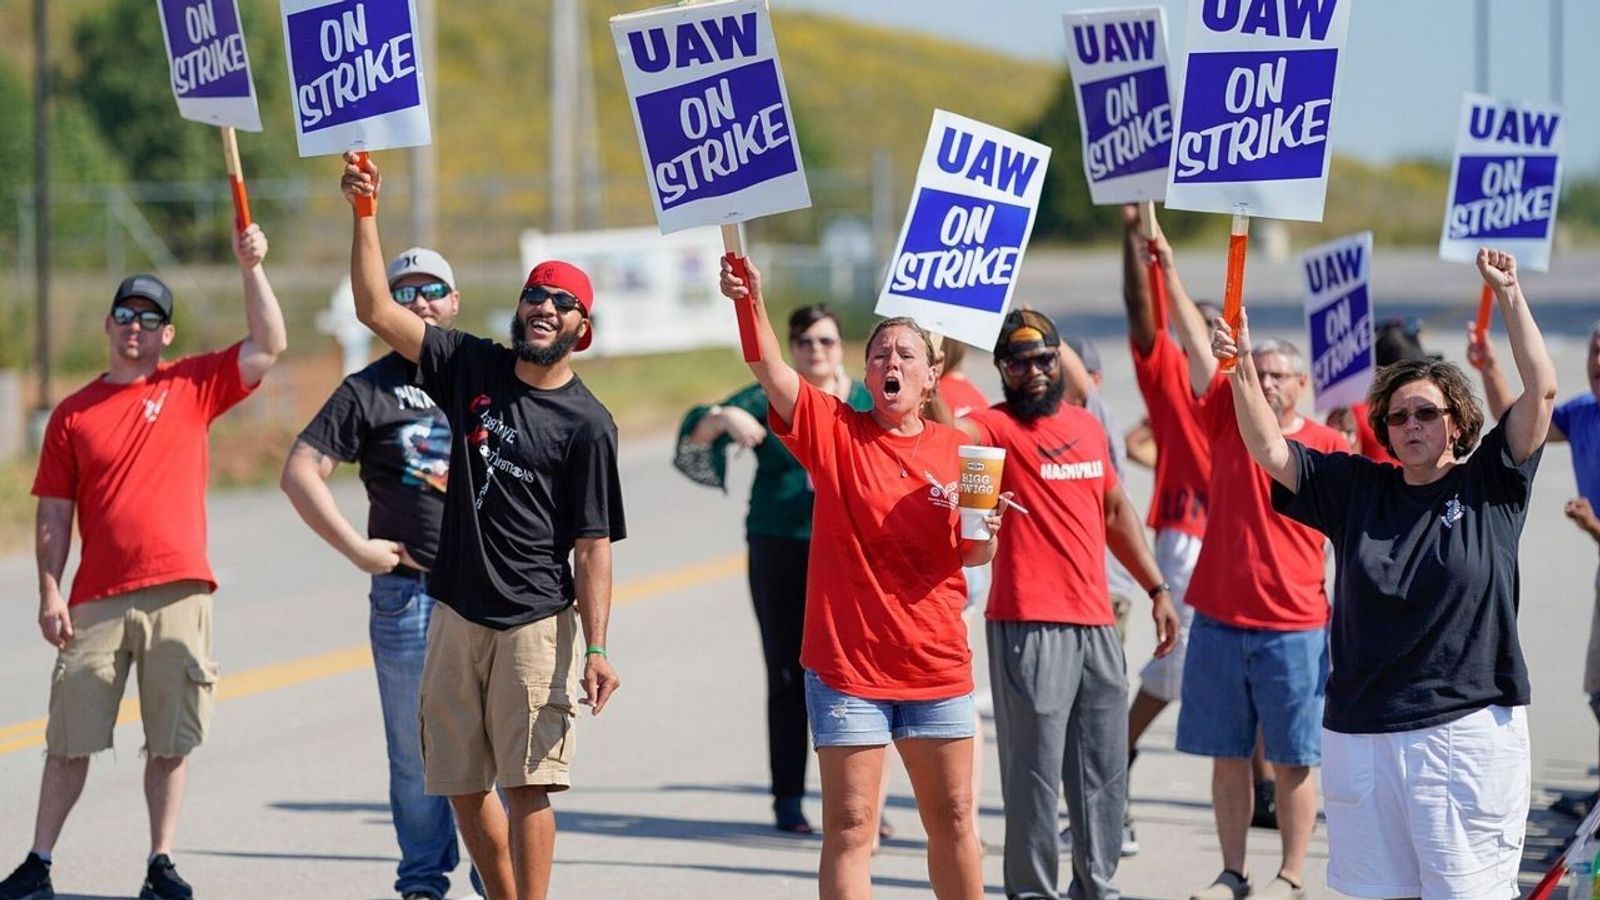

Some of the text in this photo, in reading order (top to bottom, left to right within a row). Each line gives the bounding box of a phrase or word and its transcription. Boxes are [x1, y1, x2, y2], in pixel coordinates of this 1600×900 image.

[185, 0, 217, 44] ON
[320, 3, 368, 62] ON
[627, 12, 758, 73] UAW
[1073, 20, 1156, 65] UAW
[1202, 0, 1338, 41] UAW
[173, 33, 246, 95] STRIKE
[300, 32, 416, 127] STRIKE
[1225, 56, 1287, 114] ON
[680, 78, 736, 140] ON
[1105, 76, 1138, 126] ON
[1469, 106, 1560, 147] UAW
[656, 102, 790, 204] STRIKE
[936, 126, 1040, 198] UAW
[1088, 103, 1173, 181] STRIKE
[1176, 98, 1331, 178] STRIKE
[1481, 156, 1526, 198] ON
[940, 204, 995, 247] ON
[1450, 185, 1554, 239] STRIKE
[892, 246, 1020, 292] STRIKE
[1306, 246, 1363, 294] UAW
[1325, 296, 1351, 342] ON
[1313, 313, 1371, 387] STRIKE
[962, 473, 990, 484] BIGG
[1041, 461, 1103, 480] NASHVILLE
